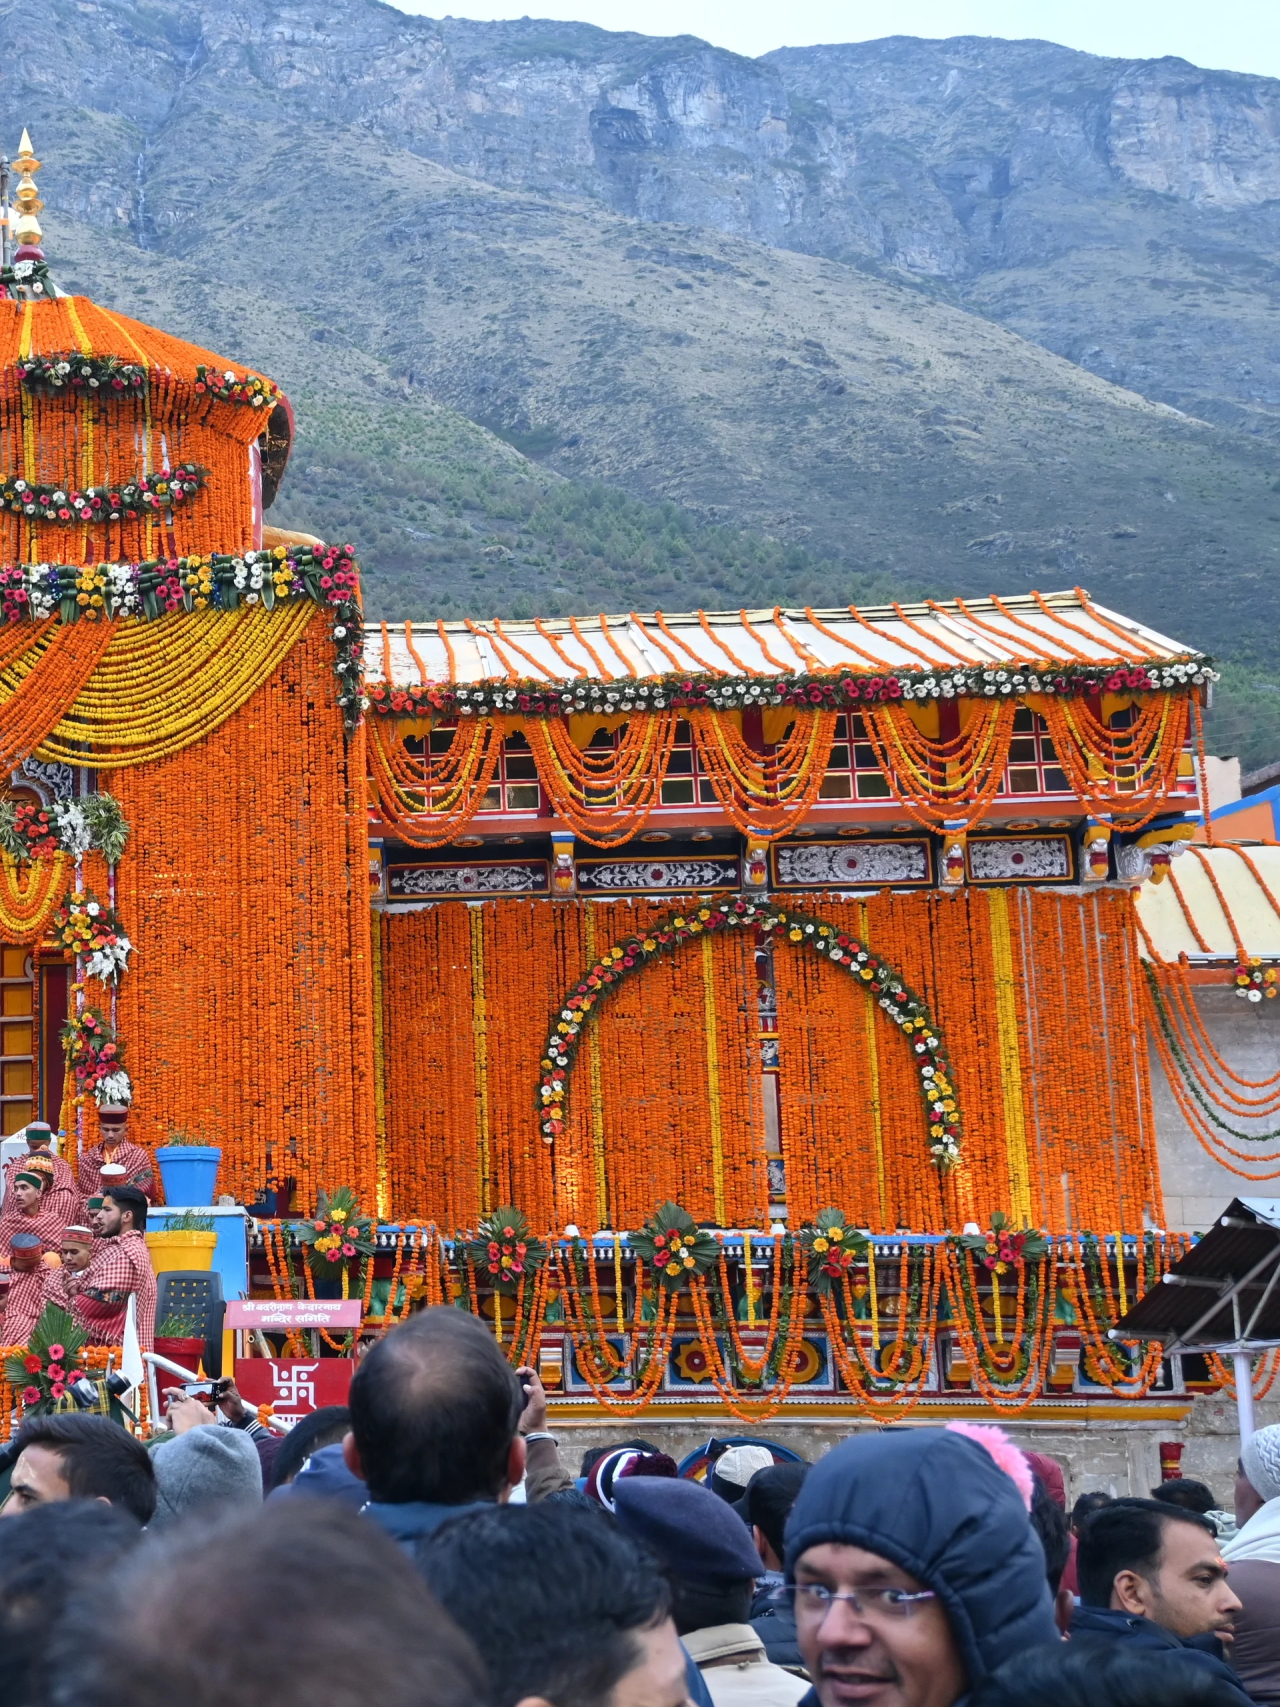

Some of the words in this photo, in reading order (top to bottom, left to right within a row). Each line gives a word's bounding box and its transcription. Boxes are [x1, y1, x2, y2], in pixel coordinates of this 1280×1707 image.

[242, 1301, 255, 1312] श्री
[297, 1301, 343, 1312] केदारनाथ
[261, 1311, 292, 1324] मन्दिर
[294, 1313, 331, 1324] समिति
